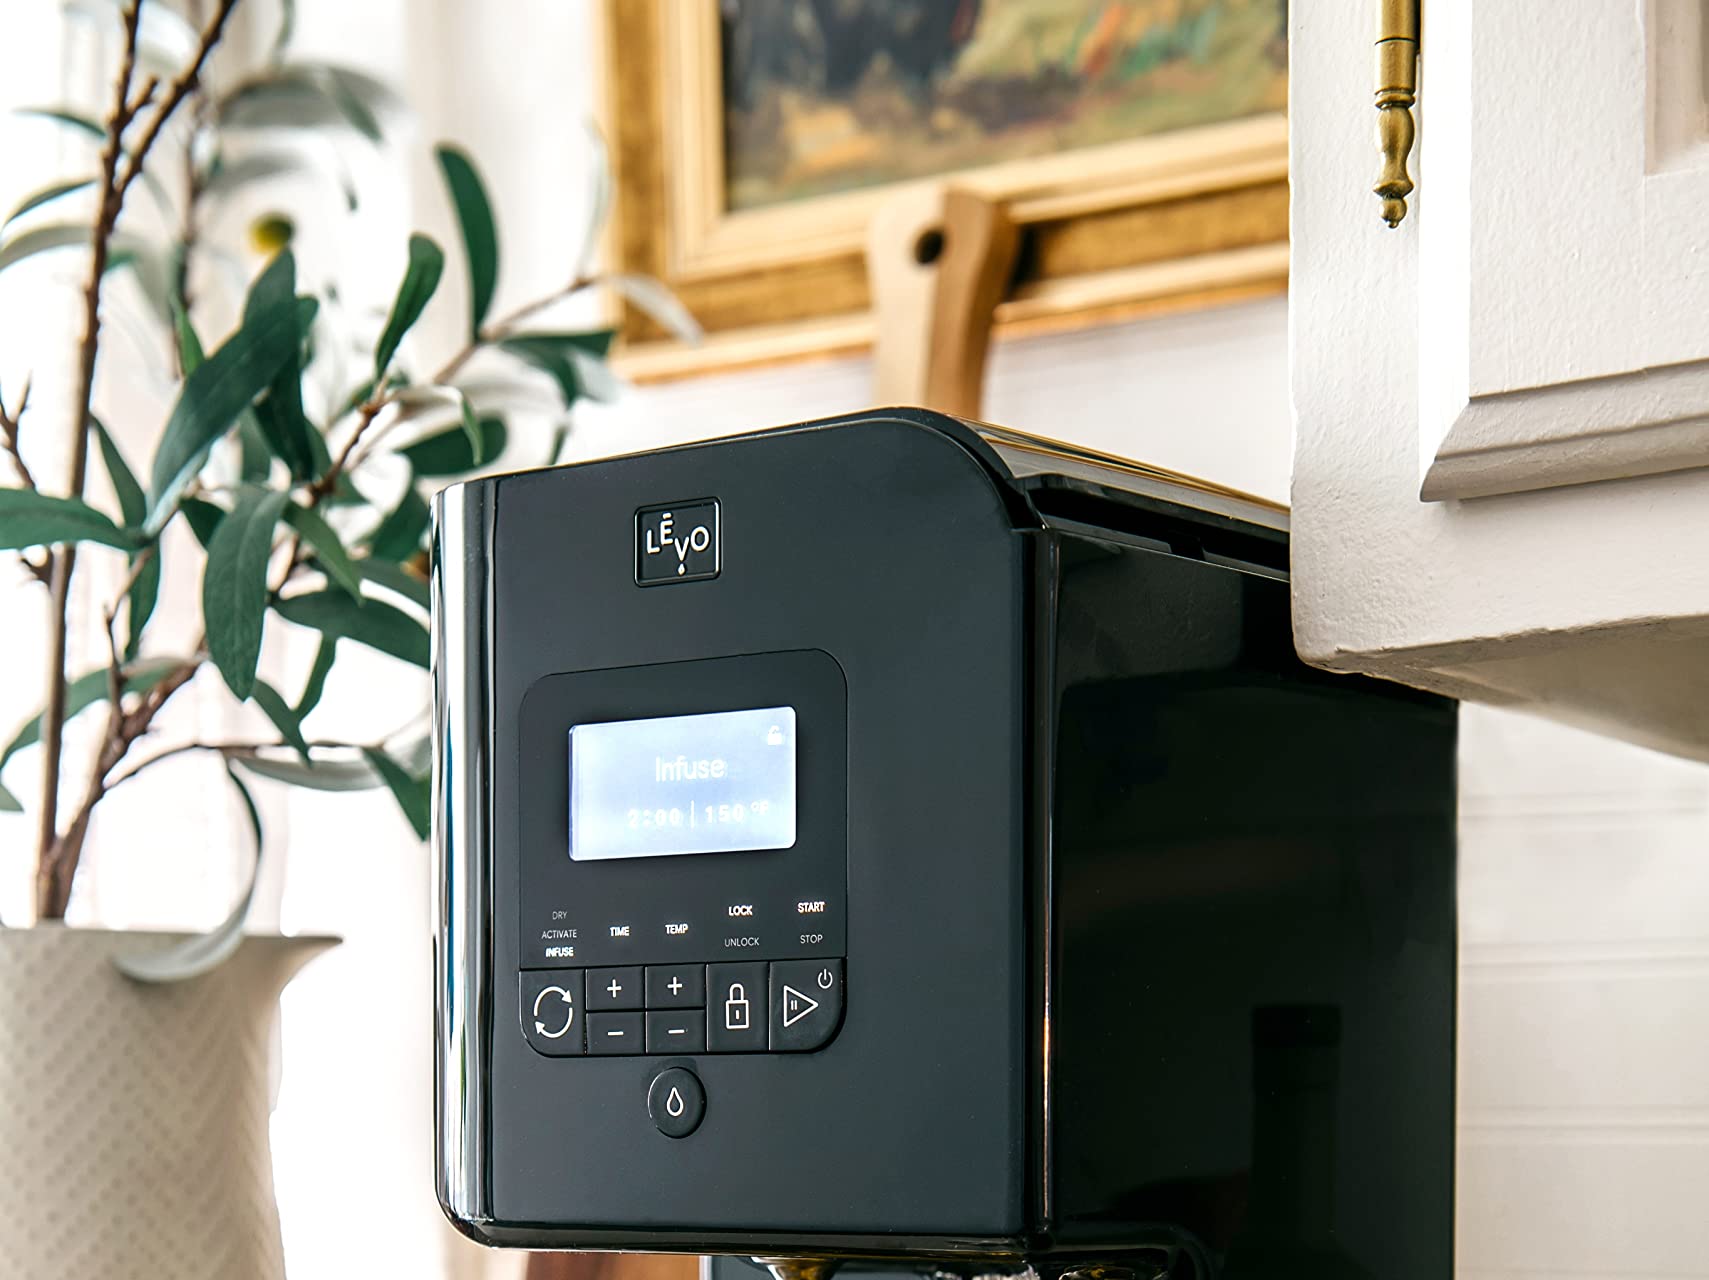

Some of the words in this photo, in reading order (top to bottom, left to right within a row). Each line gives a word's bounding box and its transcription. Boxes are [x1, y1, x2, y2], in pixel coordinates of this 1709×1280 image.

[655, 754, 727, 783] Infuse
[728, 904, 753, 917] LOCK
[797, 901, 825, 914] START
[551, 911, 568, 921] DRY
[541, 928, 578, 940] ACTIVATE
[609, 925, 630, 937] TIME
[665, 923, 689, 936] TEMP
[724, 936, 760, 948] UNLOCK
[799, 934, 823, 945] STOP
[545, 946, 574, 958] INFUSE
